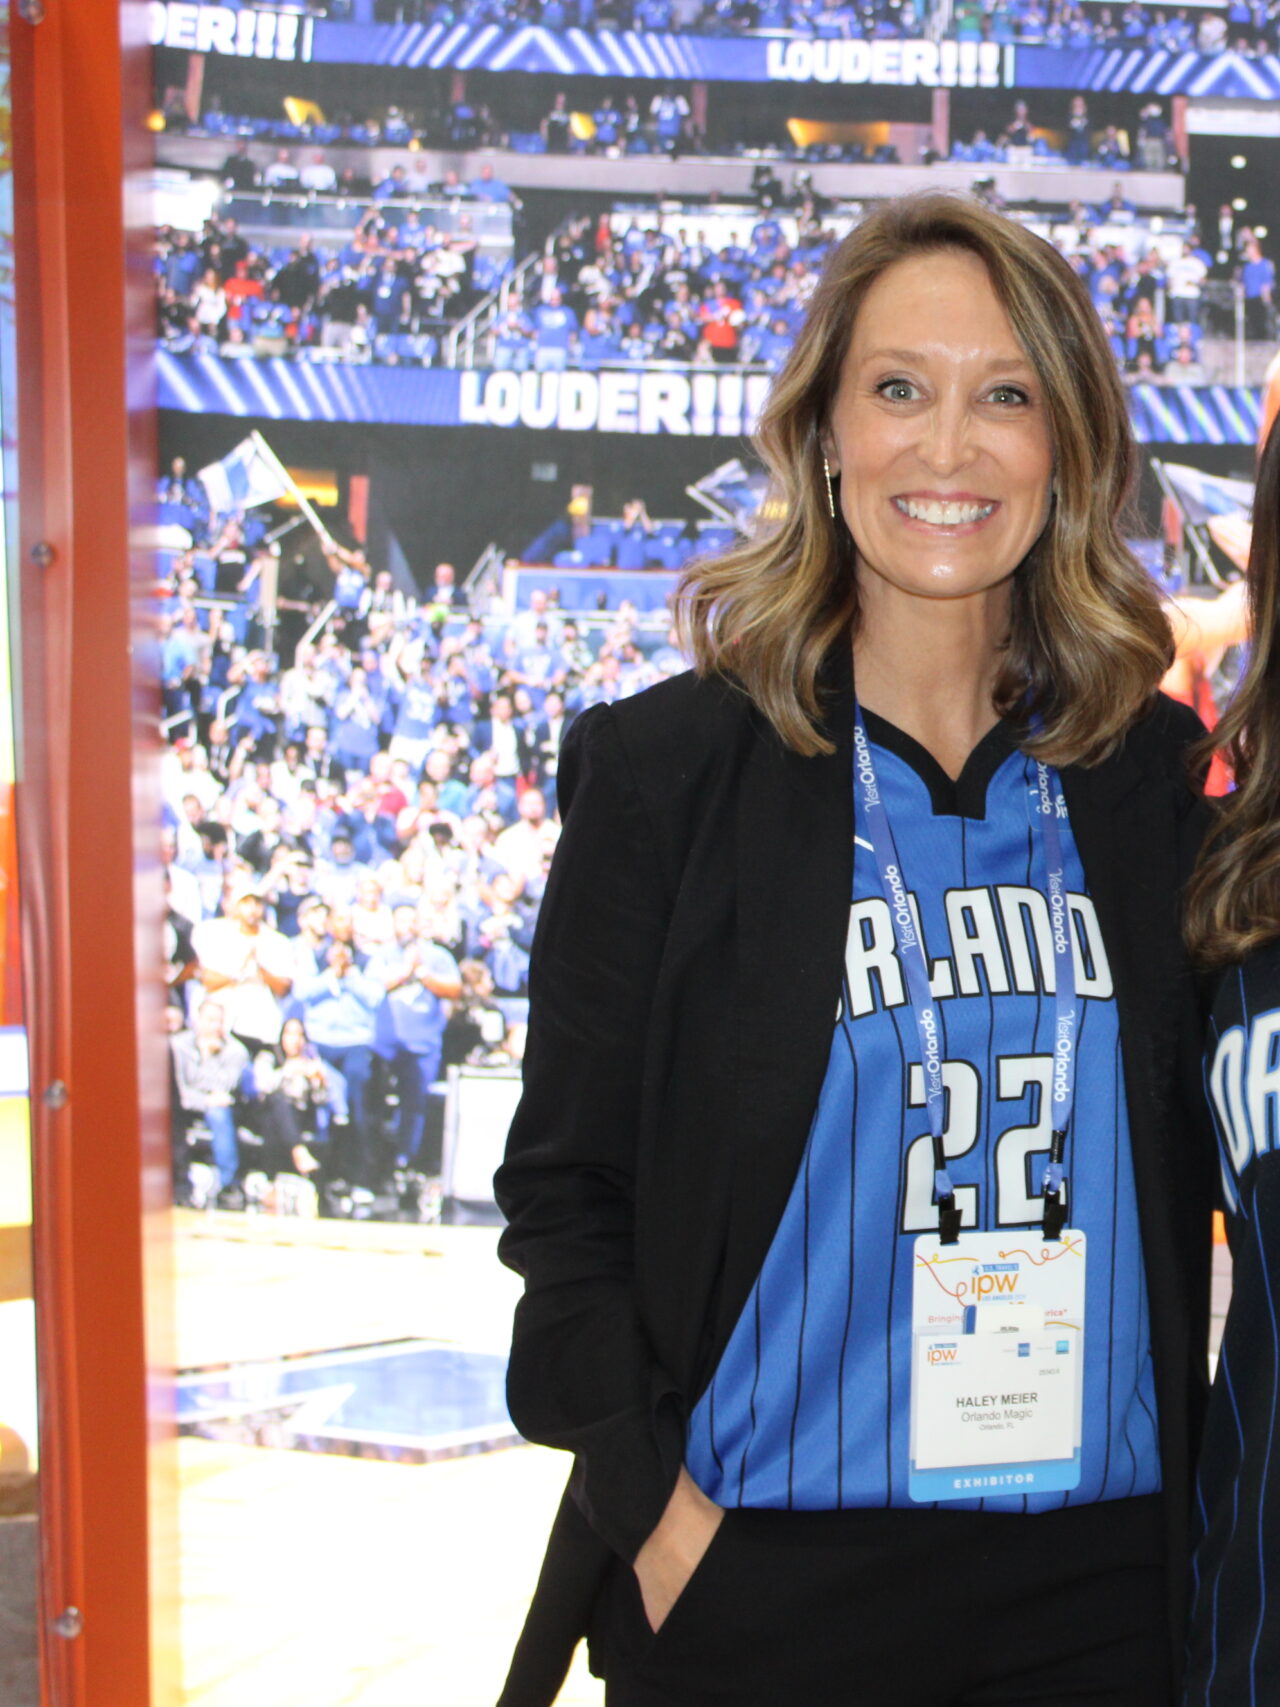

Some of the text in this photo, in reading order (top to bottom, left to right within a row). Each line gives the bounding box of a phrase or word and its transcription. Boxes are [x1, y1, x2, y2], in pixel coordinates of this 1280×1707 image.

[767, 39, 999, 87] LOUDER!!!
[460, 371, 770, 436] LOUDER!!!
[900, 1052, 1069, 1235] 22
[971, 1273, 1019, 1301] ipw
[956, 1392, 1038, 1408] HALEY MEIER
[961, 1408, 1033, 1422] Orlando Magic
[953, 1473, 1035, 1489] EXHIBITOR
